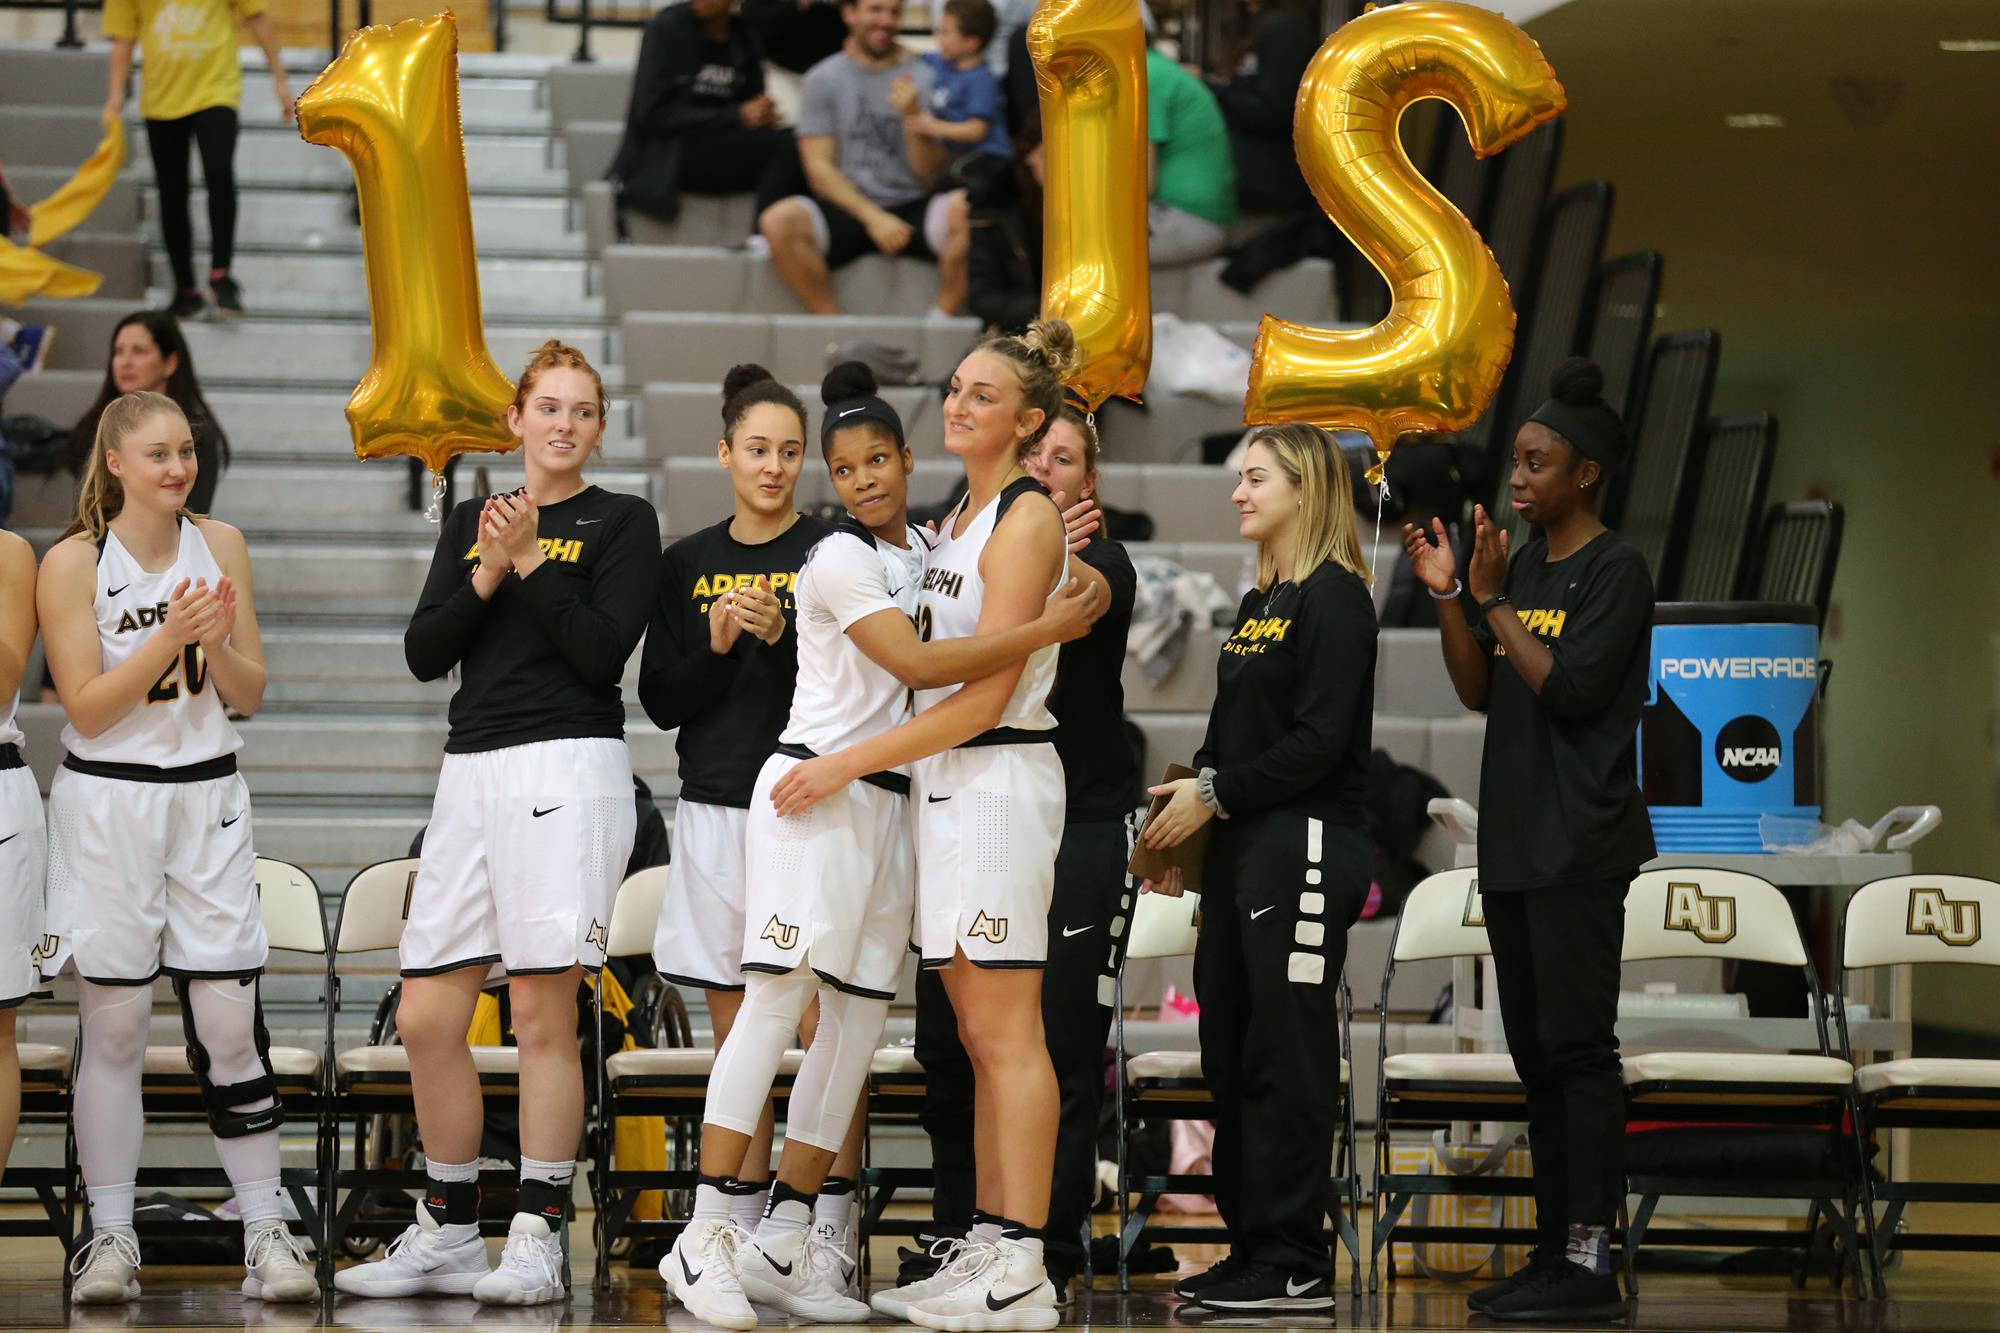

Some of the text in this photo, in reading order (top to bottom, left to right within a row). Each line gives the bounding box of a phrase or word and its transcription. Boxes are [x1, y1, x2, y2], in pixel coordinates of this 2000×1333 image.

[294, 8, 522, 470] 1
[1660, 656, 1817, 680] POWERADE
[1721, 746, 1781, 768] NCAA
[967, 909, 1009, 945] AU
[1664, 881, 1736, 944] AU
[1905, 887, 1982, 947] AU
[760, 913, 800, 951] AU
